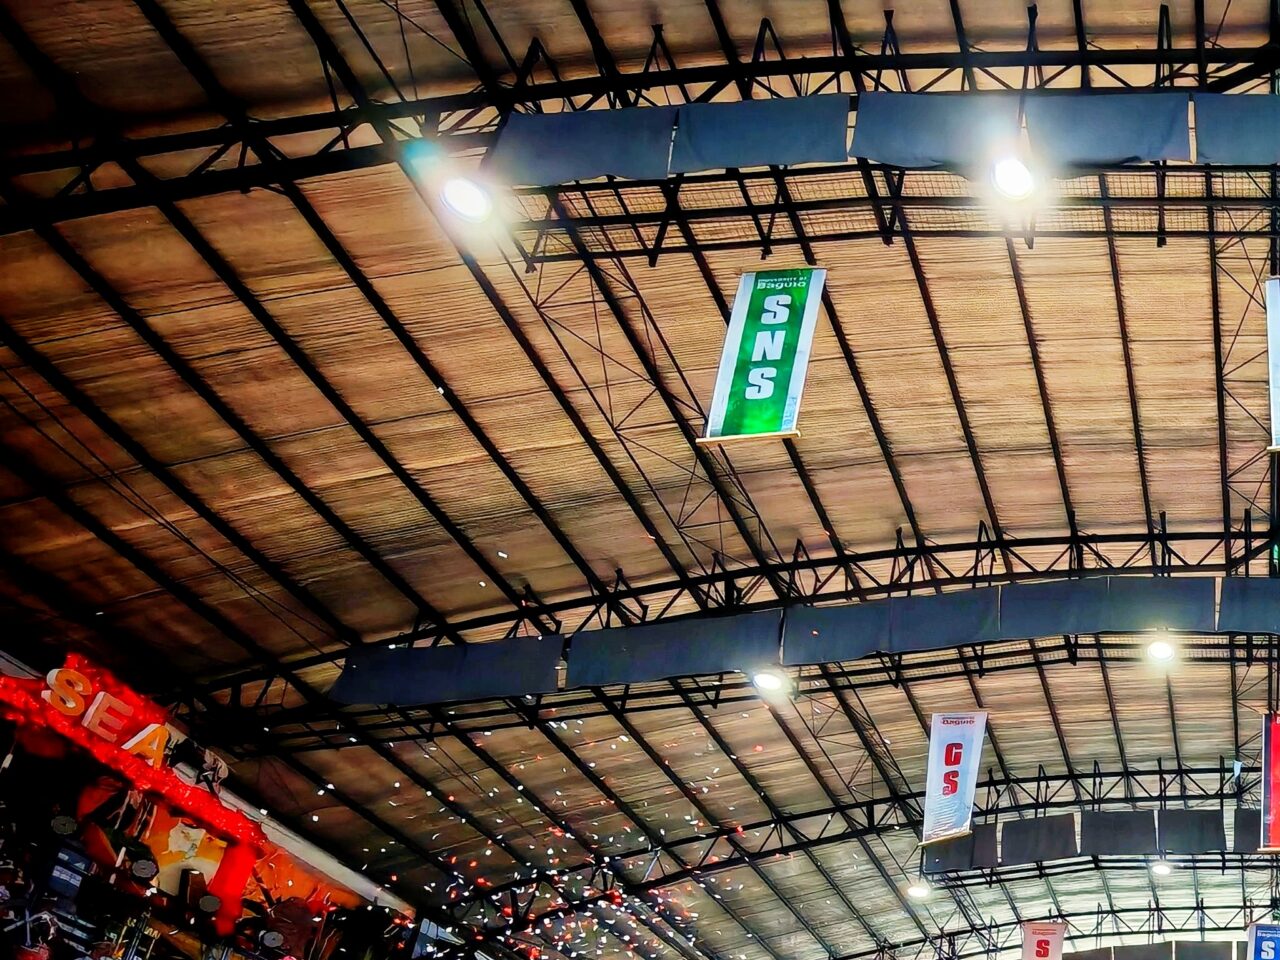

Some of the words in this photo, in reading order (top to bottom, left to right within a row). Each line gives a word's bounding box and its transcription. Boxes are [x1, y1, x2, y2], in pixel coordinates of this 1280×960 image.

[757, 280, 807, 290] Baguio
[745, 294, 792, 400] SNS
[41, 668, 170, 770] SEA
[942, 742, 964, 796] GS
